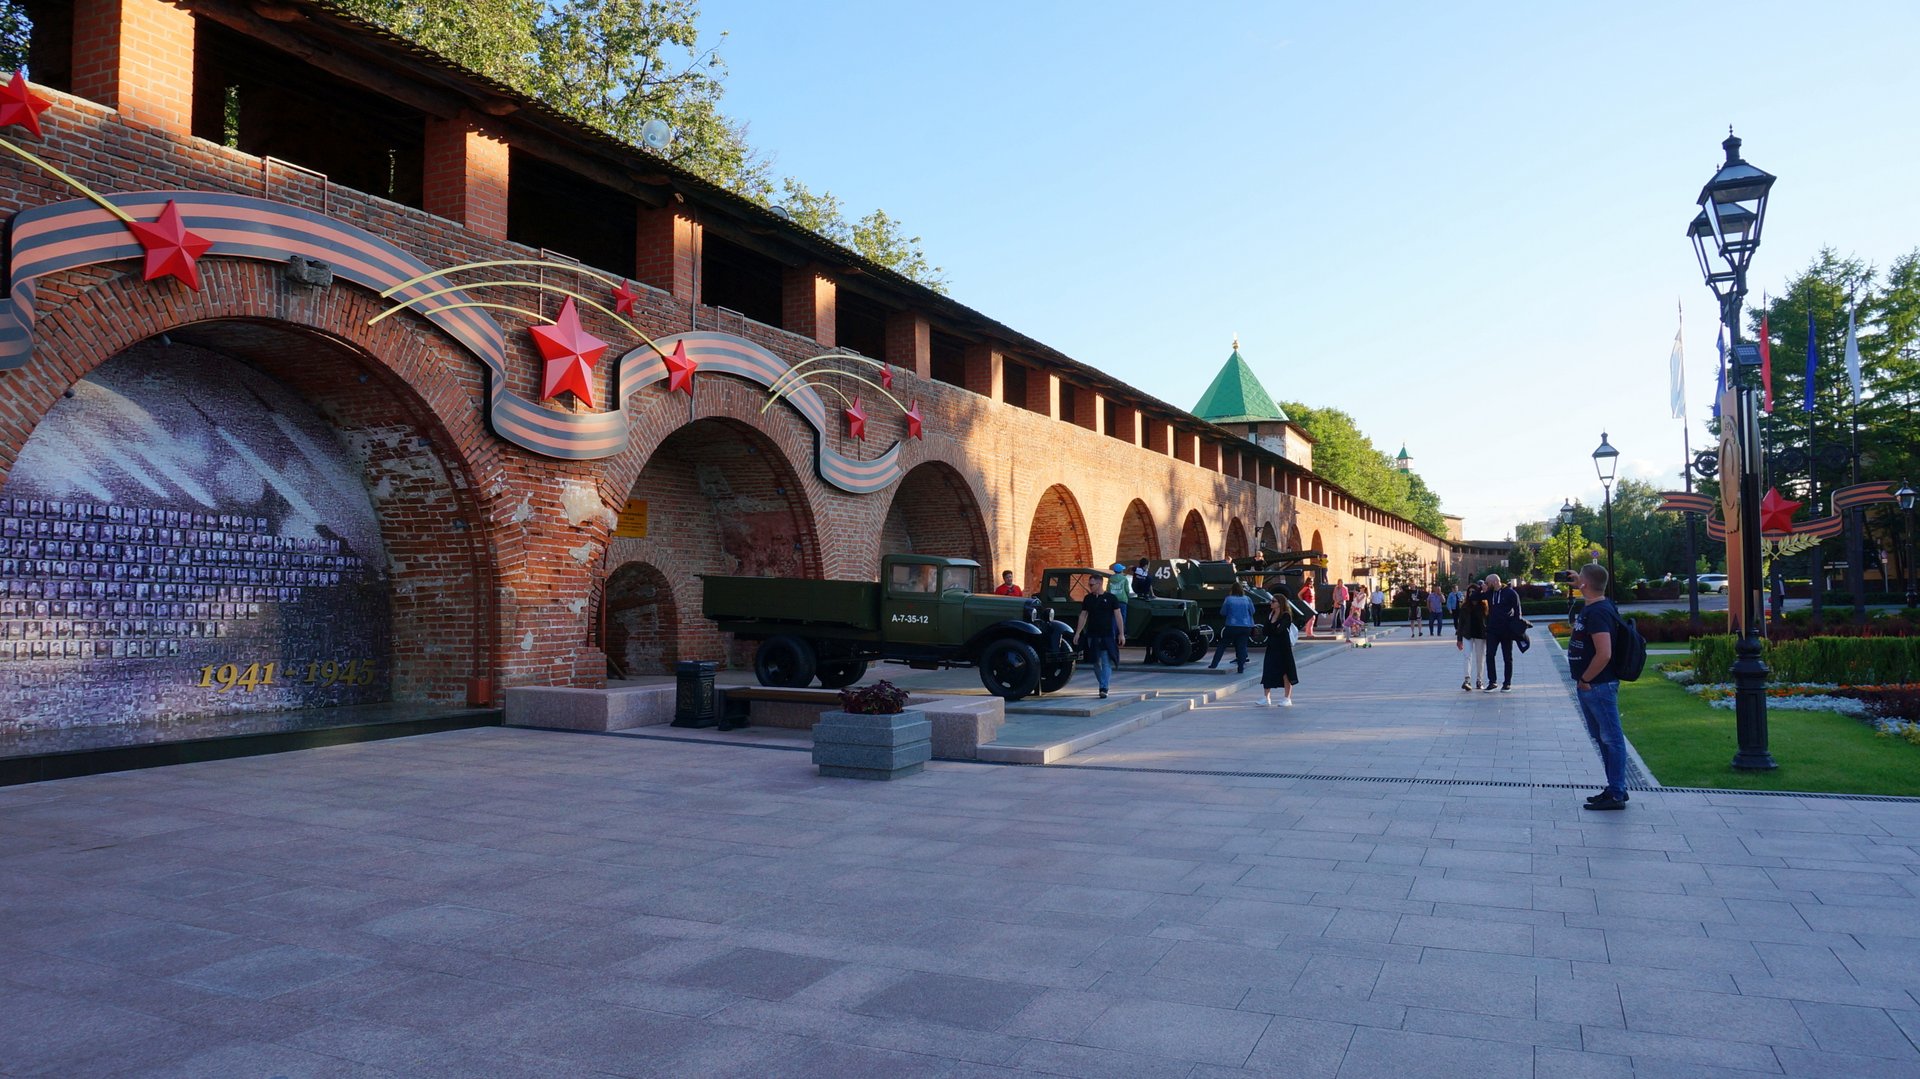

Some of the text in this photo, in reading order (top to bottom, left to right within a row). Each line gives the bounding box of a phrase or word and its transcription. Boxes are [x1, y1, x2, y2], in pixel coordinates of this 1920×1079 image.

[1155, 566, 1171, 579] 45
[198, 662, 276, 693] 1941
[304, 660, 376, 687] 1945
